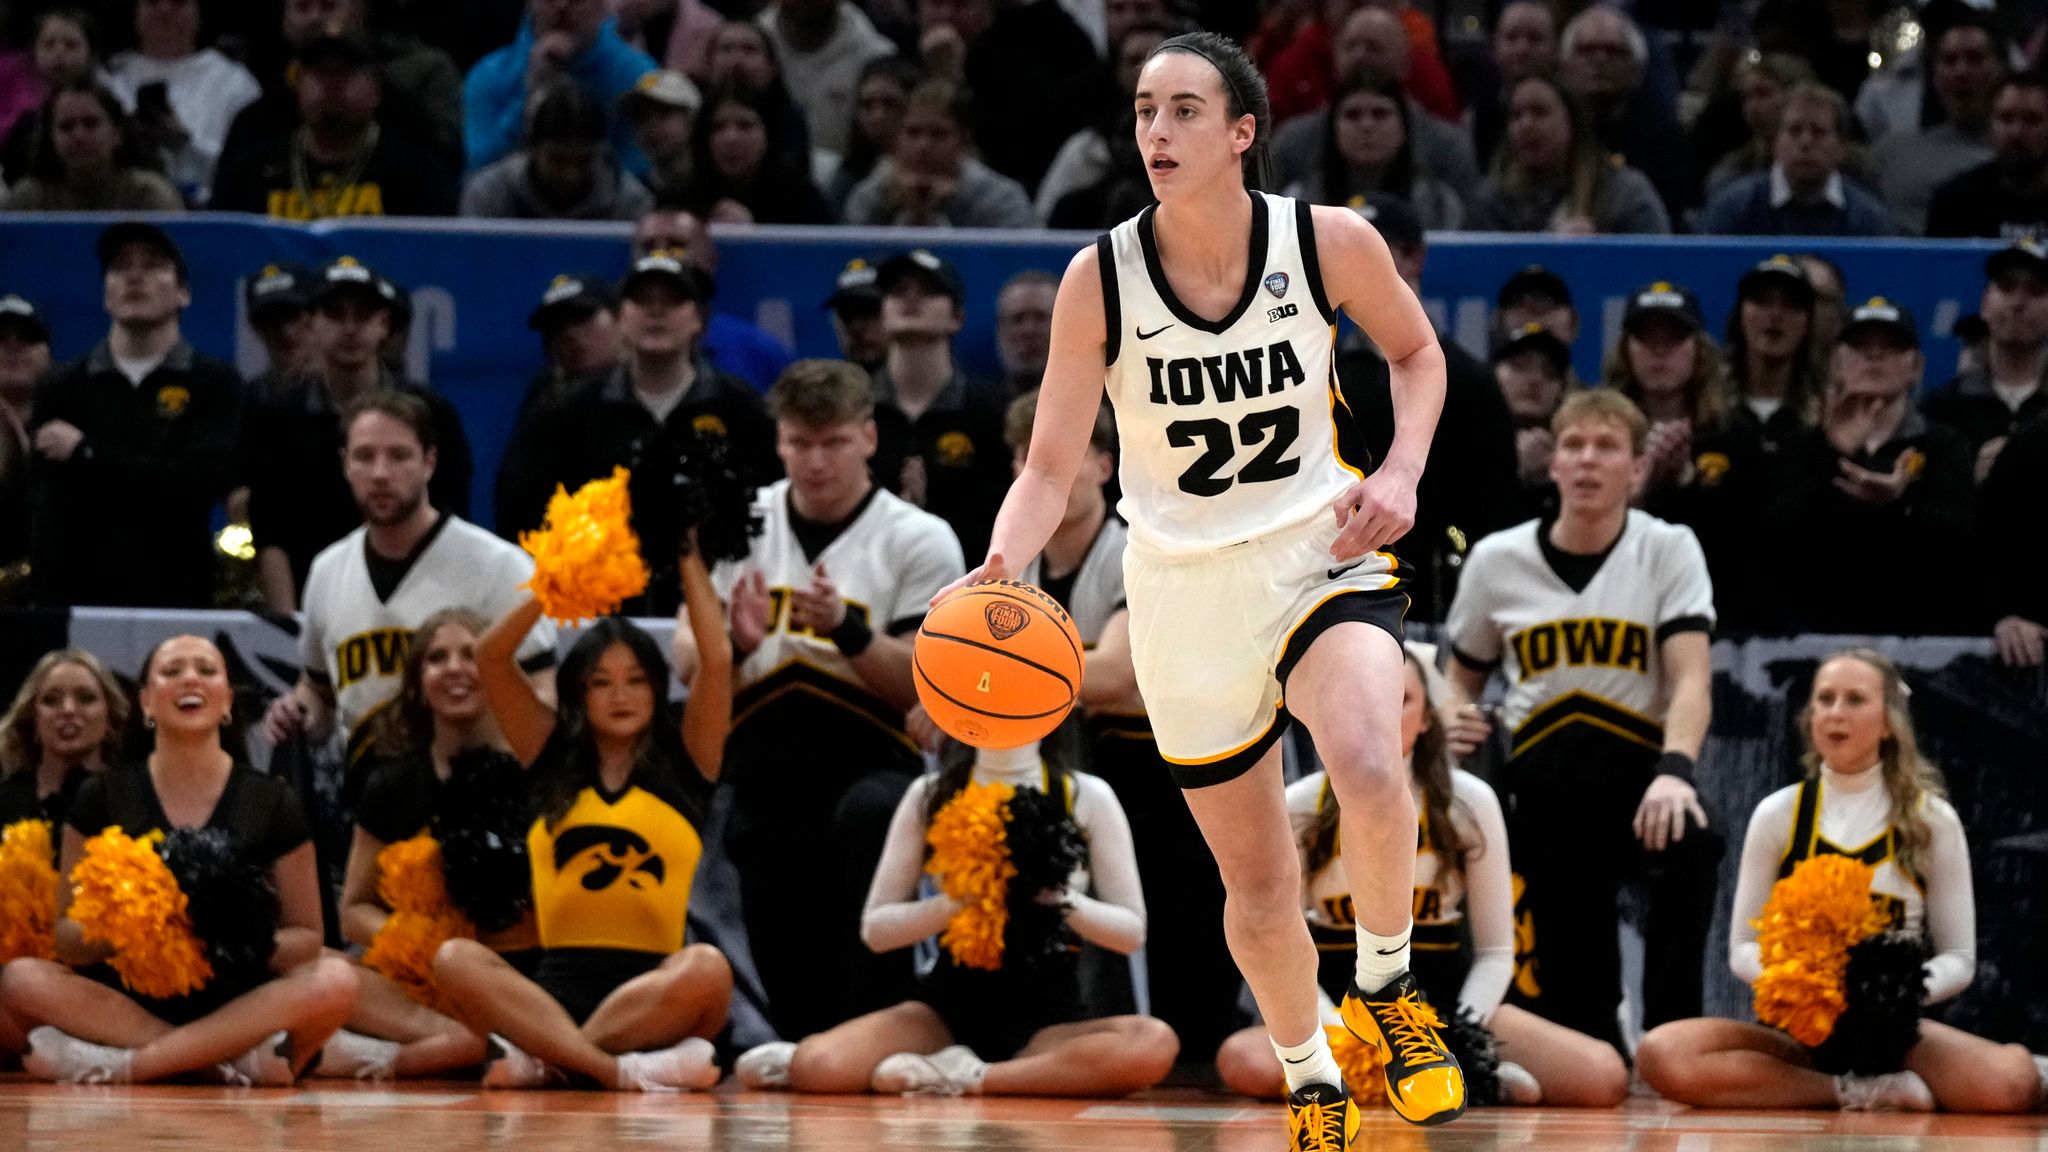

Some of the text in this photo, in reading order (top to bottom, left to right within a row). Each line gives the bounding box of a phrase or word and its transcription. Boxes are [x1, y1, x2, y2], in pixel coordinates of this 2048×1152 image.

[1146, 339, 1305, 405] IOWA
[1166, 405, 1301, 497] 22
[991, 614, 1018, 629] FOUR
[995, 607, 1020, 621] FINAL
[336, 626, 417, 690] IOW
[1511, 617, 1649, 684] IOWA
